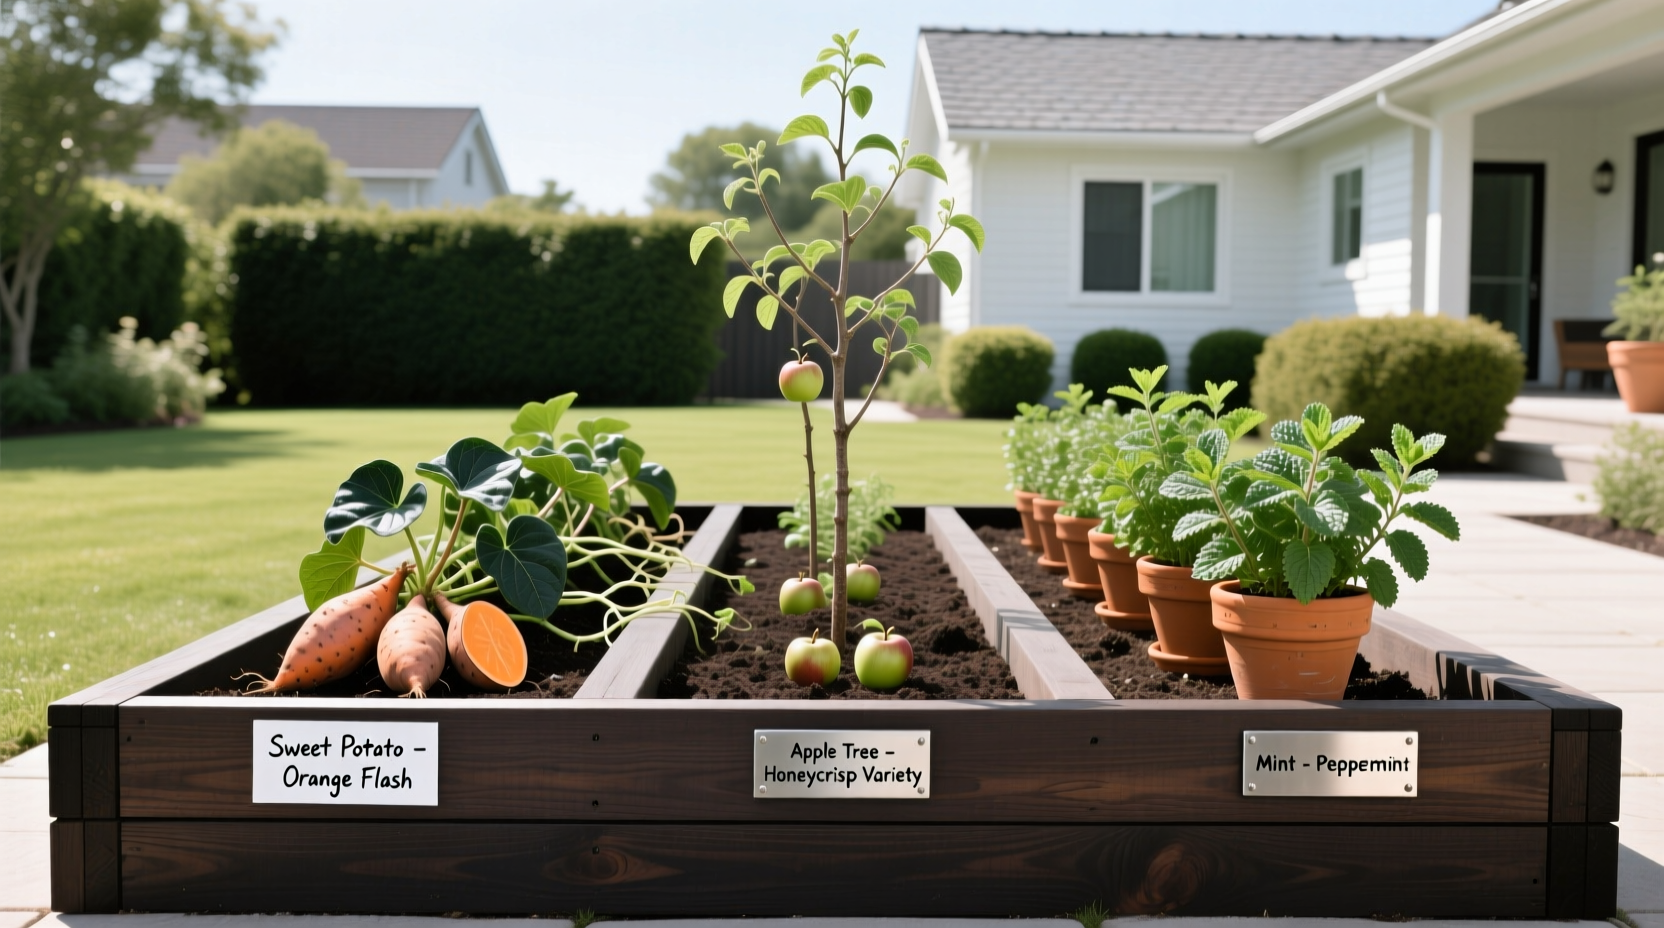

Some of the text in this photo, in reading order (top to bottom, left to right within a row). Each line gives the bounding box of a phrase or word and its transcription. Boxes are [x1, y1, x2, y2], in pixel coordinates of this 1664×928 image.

[268, 733, 332, 758] Sweet
[341, 733, 404, 758] Potato
[790, 742, 837, 765] Apple
[842, 743, 879, 759] Tree
[1256, 754, 1296, 771] Mint
[283, 764, 413, 798] Orange Flash
[764, 765, 922, 789] Honeycrisp Variety
